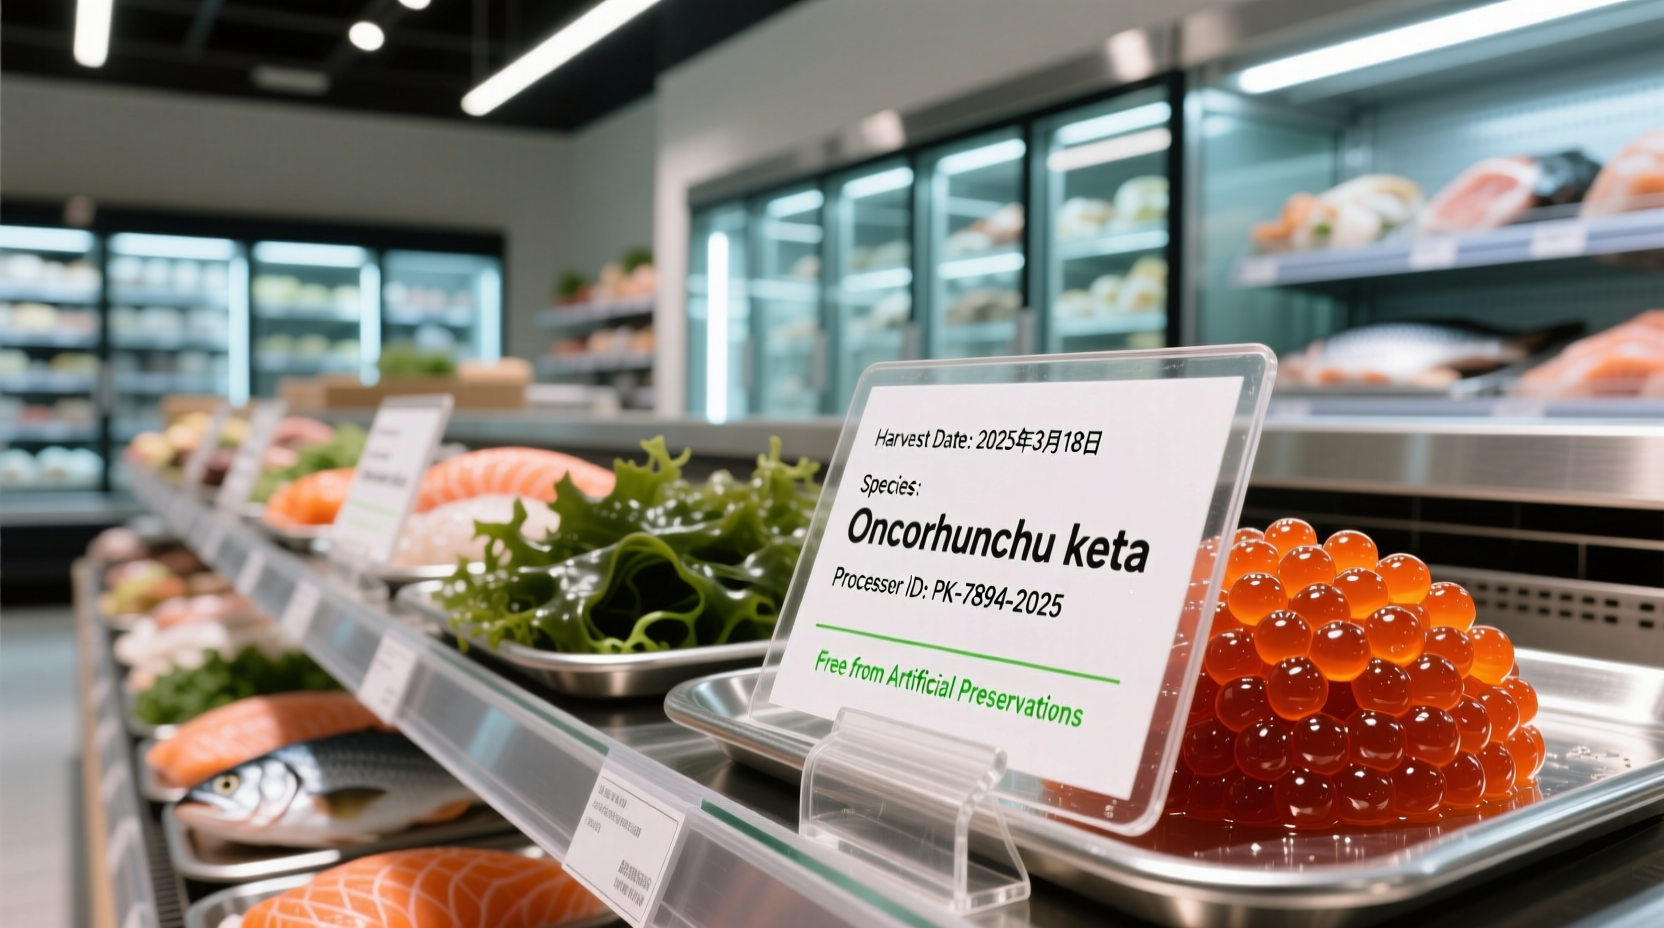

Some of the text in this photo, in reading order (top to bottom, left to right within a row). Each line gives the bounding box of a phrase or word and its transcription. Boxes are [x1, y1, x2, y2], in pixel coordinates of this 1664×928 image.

[875, 427, 1103, 455] Harvest Date: 2025年3月18日
[860, 474, 921, 498] Species:
[847, 507, 1150, 573] Oncorhunchu keta
[832, 566, 1064, 618] Processer ID: PK-7894-2025
[815, 649, 1084, 728] Free from Artificial Preservations
